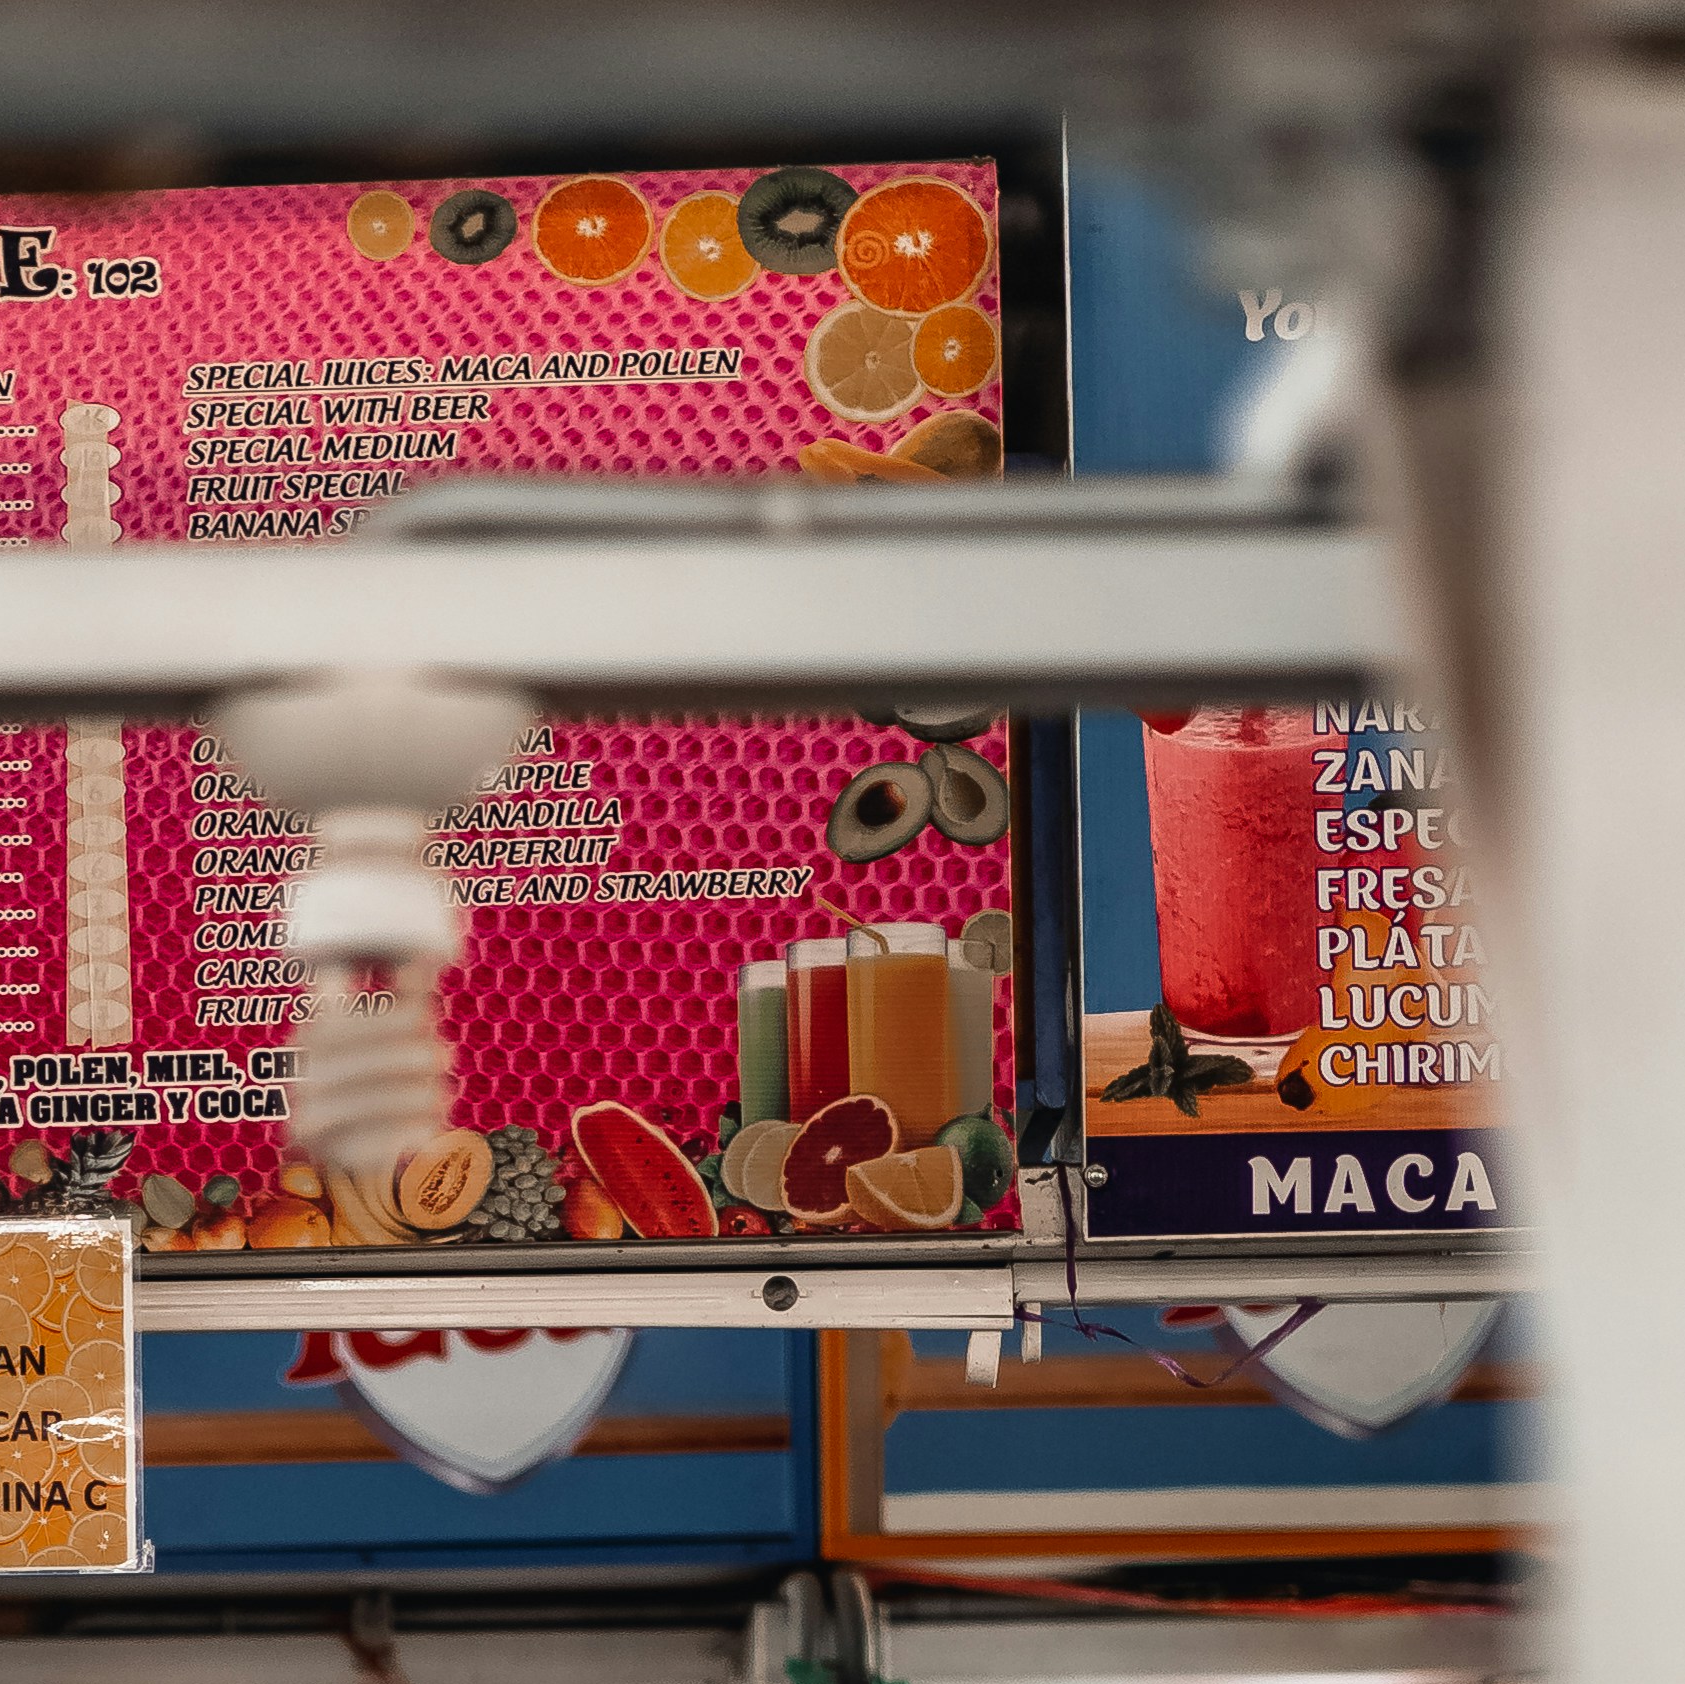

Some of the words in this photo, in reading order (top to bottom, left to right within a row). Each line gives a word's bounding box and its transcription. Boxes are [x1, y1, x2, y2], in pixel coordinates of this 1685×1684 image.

[88, 258, 160, 298] 102
[187, 363, 311, 393] SPECIAL
[441, 356, 531, 383] MACA
[541, 354, 610, 379] AND
[619, 350, 739, 377] POLLEN
[187, 400, 310, 428] SPECIAL
[324, 395, 402, 424] WITH
[411, 394, 488, 421] BEER
[187, 437, 312, 465] SPECIAL
[322, 433, 455, 461] MEDIUM
[189, 475, 281, 503] FRUIT
[282, 471, 402, 500] SPECIAL
[190, 511, 321, 539] BANANA
[424, 798, 621, 831] GRANADILLA
[194, 845, 325, 876] ORANGE
[423, 835, 619, 868] GRAPEFRUIT
[519, 874, 589, 902] AND
[595, 867, 812, 900] STRAWBERRY
[197, 996, 291, 1025] FRUIT
[13, 1056, 137, 1087] POLEN,
[146, 1053, 242, 1083] MIEL,
[30, 1093, 157, 1129] GINGER
[167, 1091, 188, 1120] Y
[198, 1089, 286, 1119] COCA
[1249, 1152, 1497, 1214] MACA
[83, 1480, 108, 1511] C
